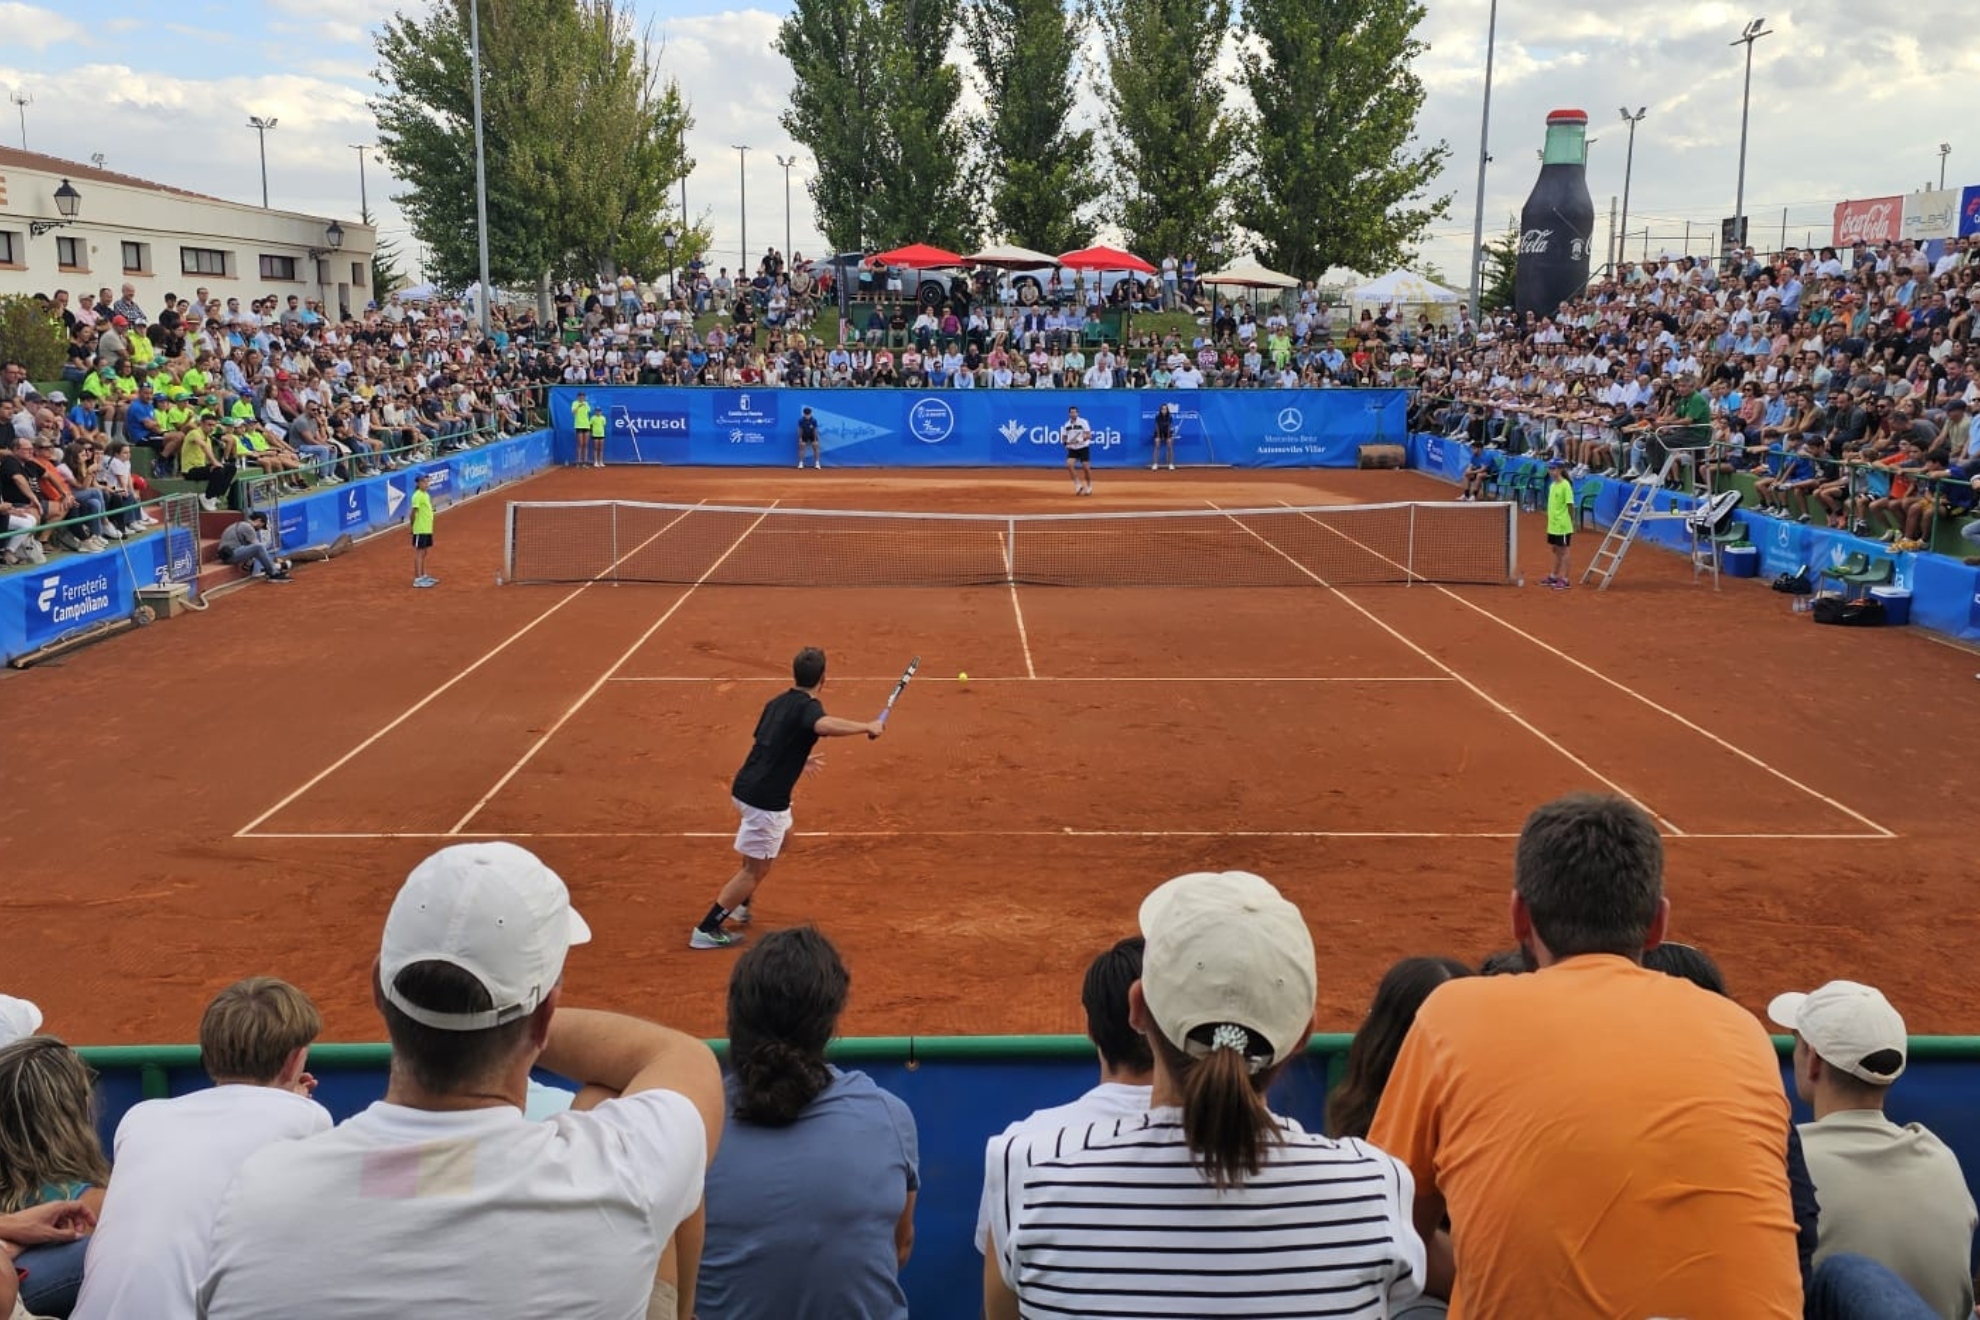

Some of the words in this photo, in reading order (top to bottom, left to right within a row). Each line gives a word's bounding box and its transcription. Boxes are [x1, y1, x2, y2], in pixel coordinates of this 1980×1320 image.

[615, 414, 686, 432] extrusol
[1030, 425, 1121, 450] Glocaja
[62, 574, 107, 601] Ferretería
[53, 595, 109, 623] Campollano
